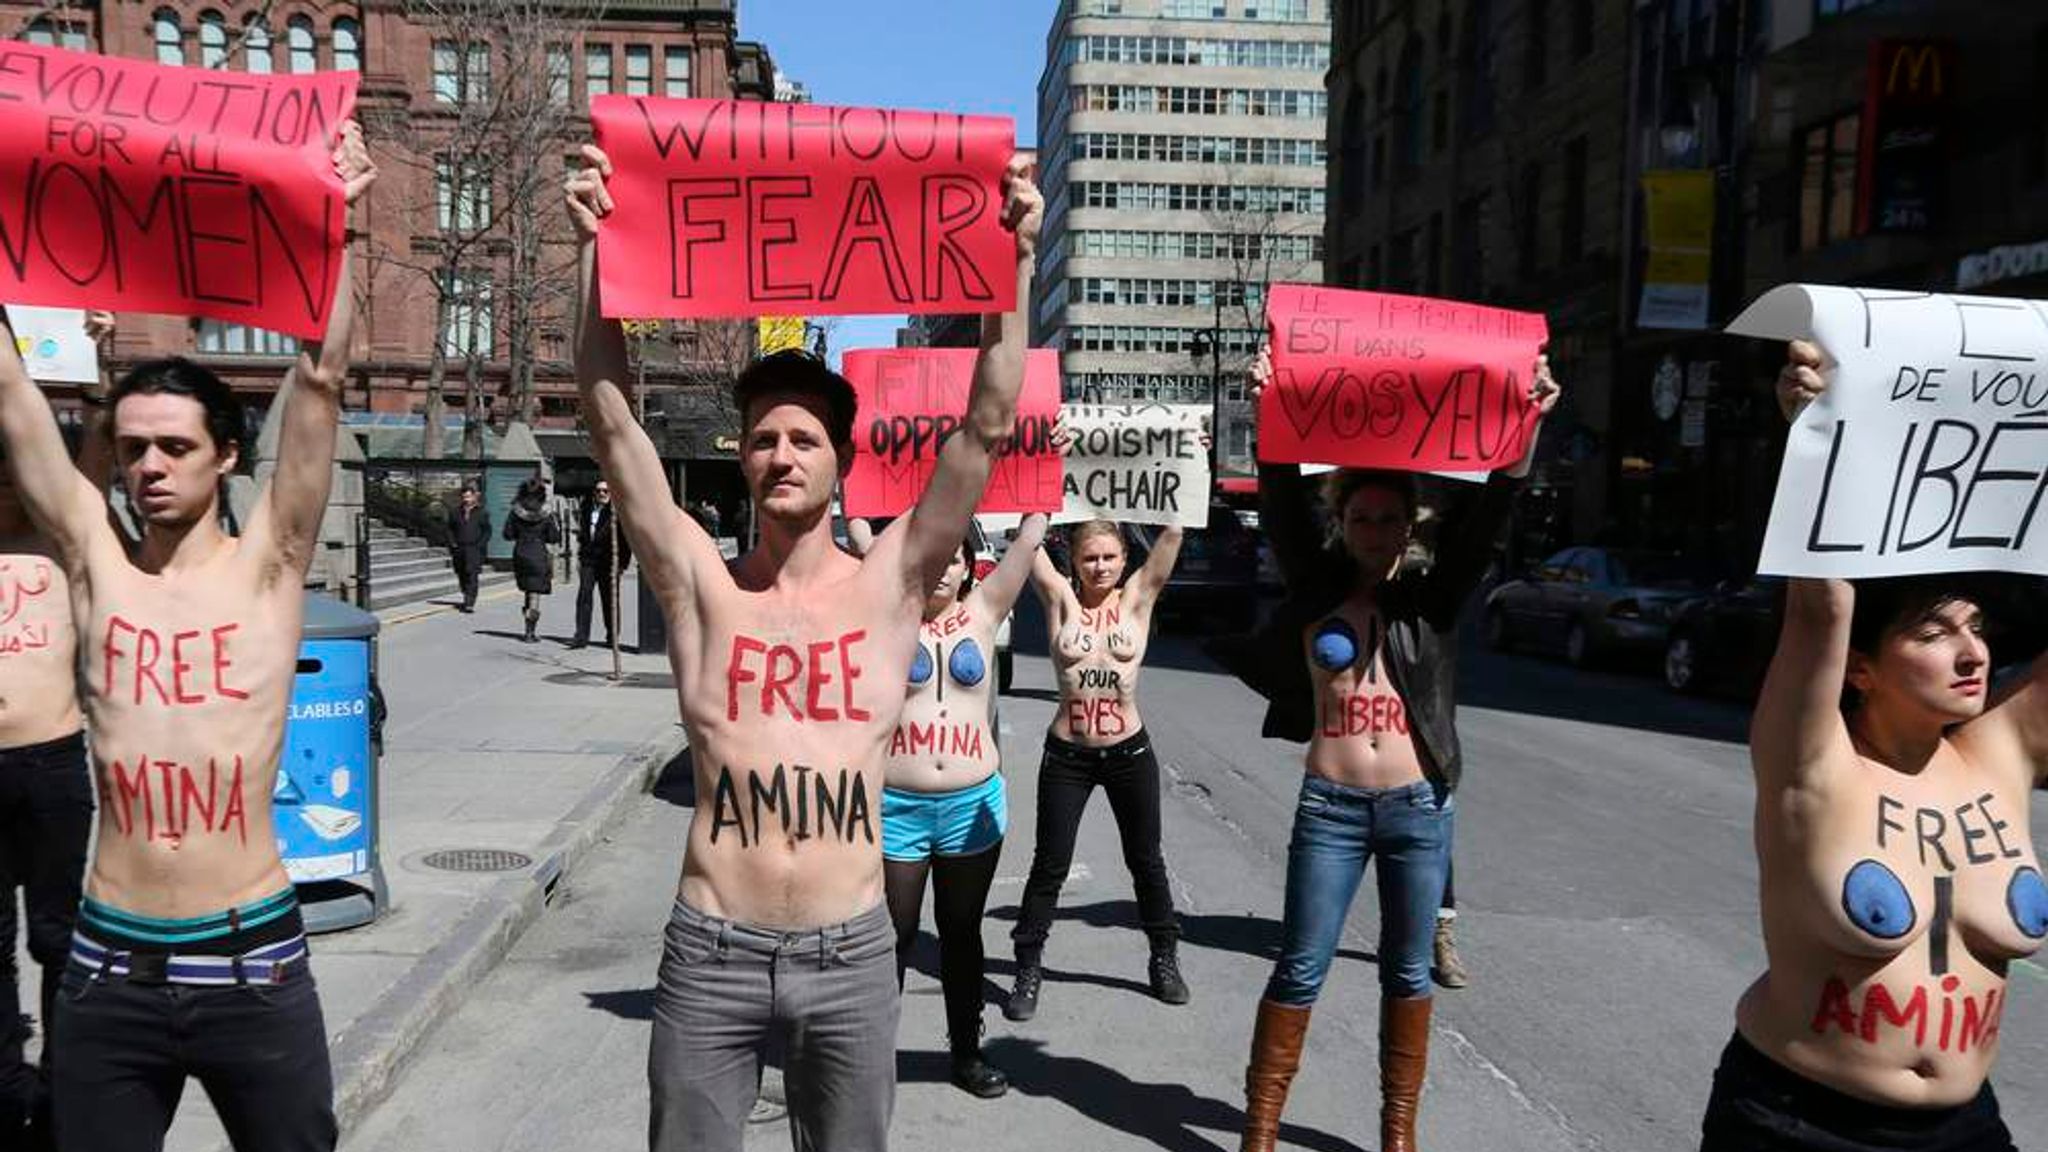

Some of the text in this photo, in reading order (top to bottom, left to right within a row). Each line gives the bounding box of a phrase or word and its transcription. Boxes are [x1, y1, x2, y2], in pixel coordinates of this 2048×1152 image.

[47, 115, 240, 178] FOR ALL
[667, 173, 994, 302] FEAR
[1287, 318, 1351, 354] EST
[1273, 366, 1406, 441] VOS
[1891, 366, 1947, 402] DE
[920, 606, 971, 638] REE
[1074, 627, 1093, 653] IS
[1081, 603, 1120, 633] SIN
[102, 615, 250, 706] FREE
[727, 629, 871, 722] FREE
[1078, 668, 1121, 690] YOUR
[890, 710, 982, 761] AMINA
[1068, 697, 1127, 737] EYES
[710, 762, 874, 848] AMINA
[1876, 793, 2022, 872] FREE
